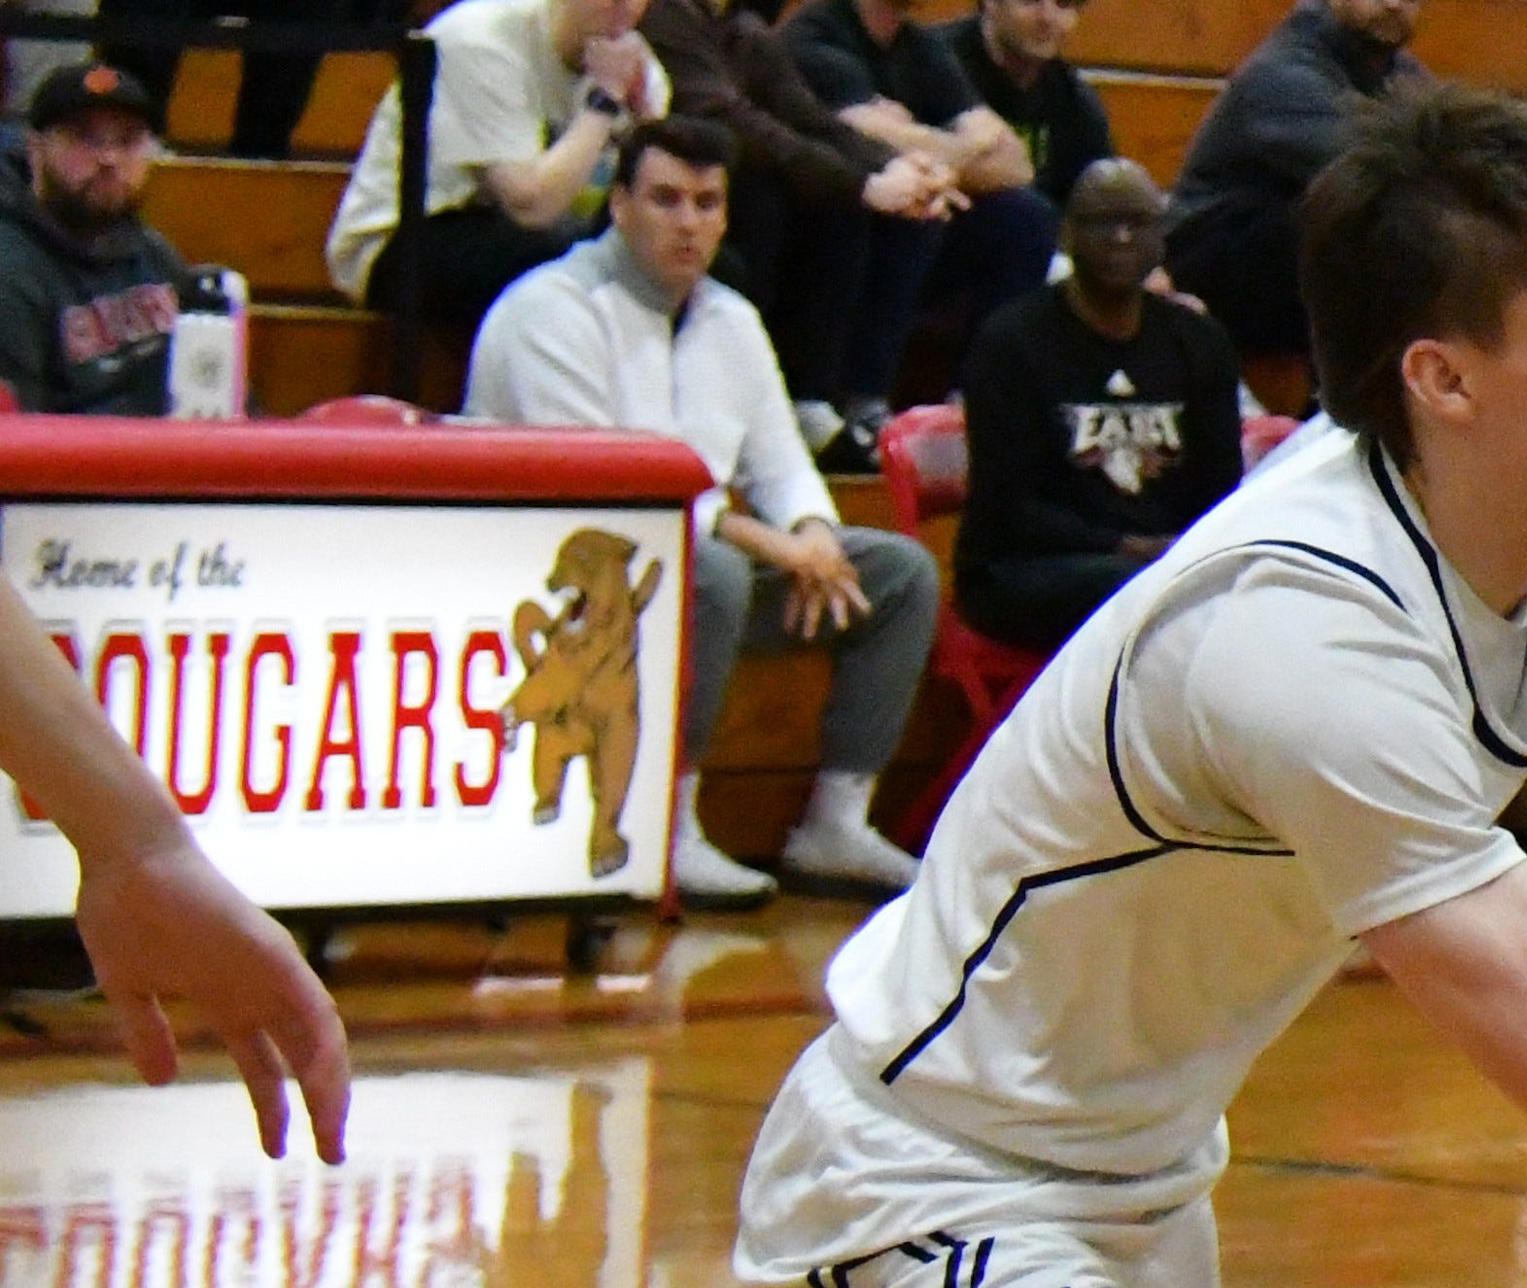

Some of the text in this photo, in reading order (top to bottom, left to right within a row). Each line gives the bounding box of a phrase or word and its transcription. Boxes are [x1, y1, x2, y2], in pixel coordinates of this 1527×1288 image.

[28, 538, 246, 602] Home of the
[20, 628, 509, 821] OUGARS
